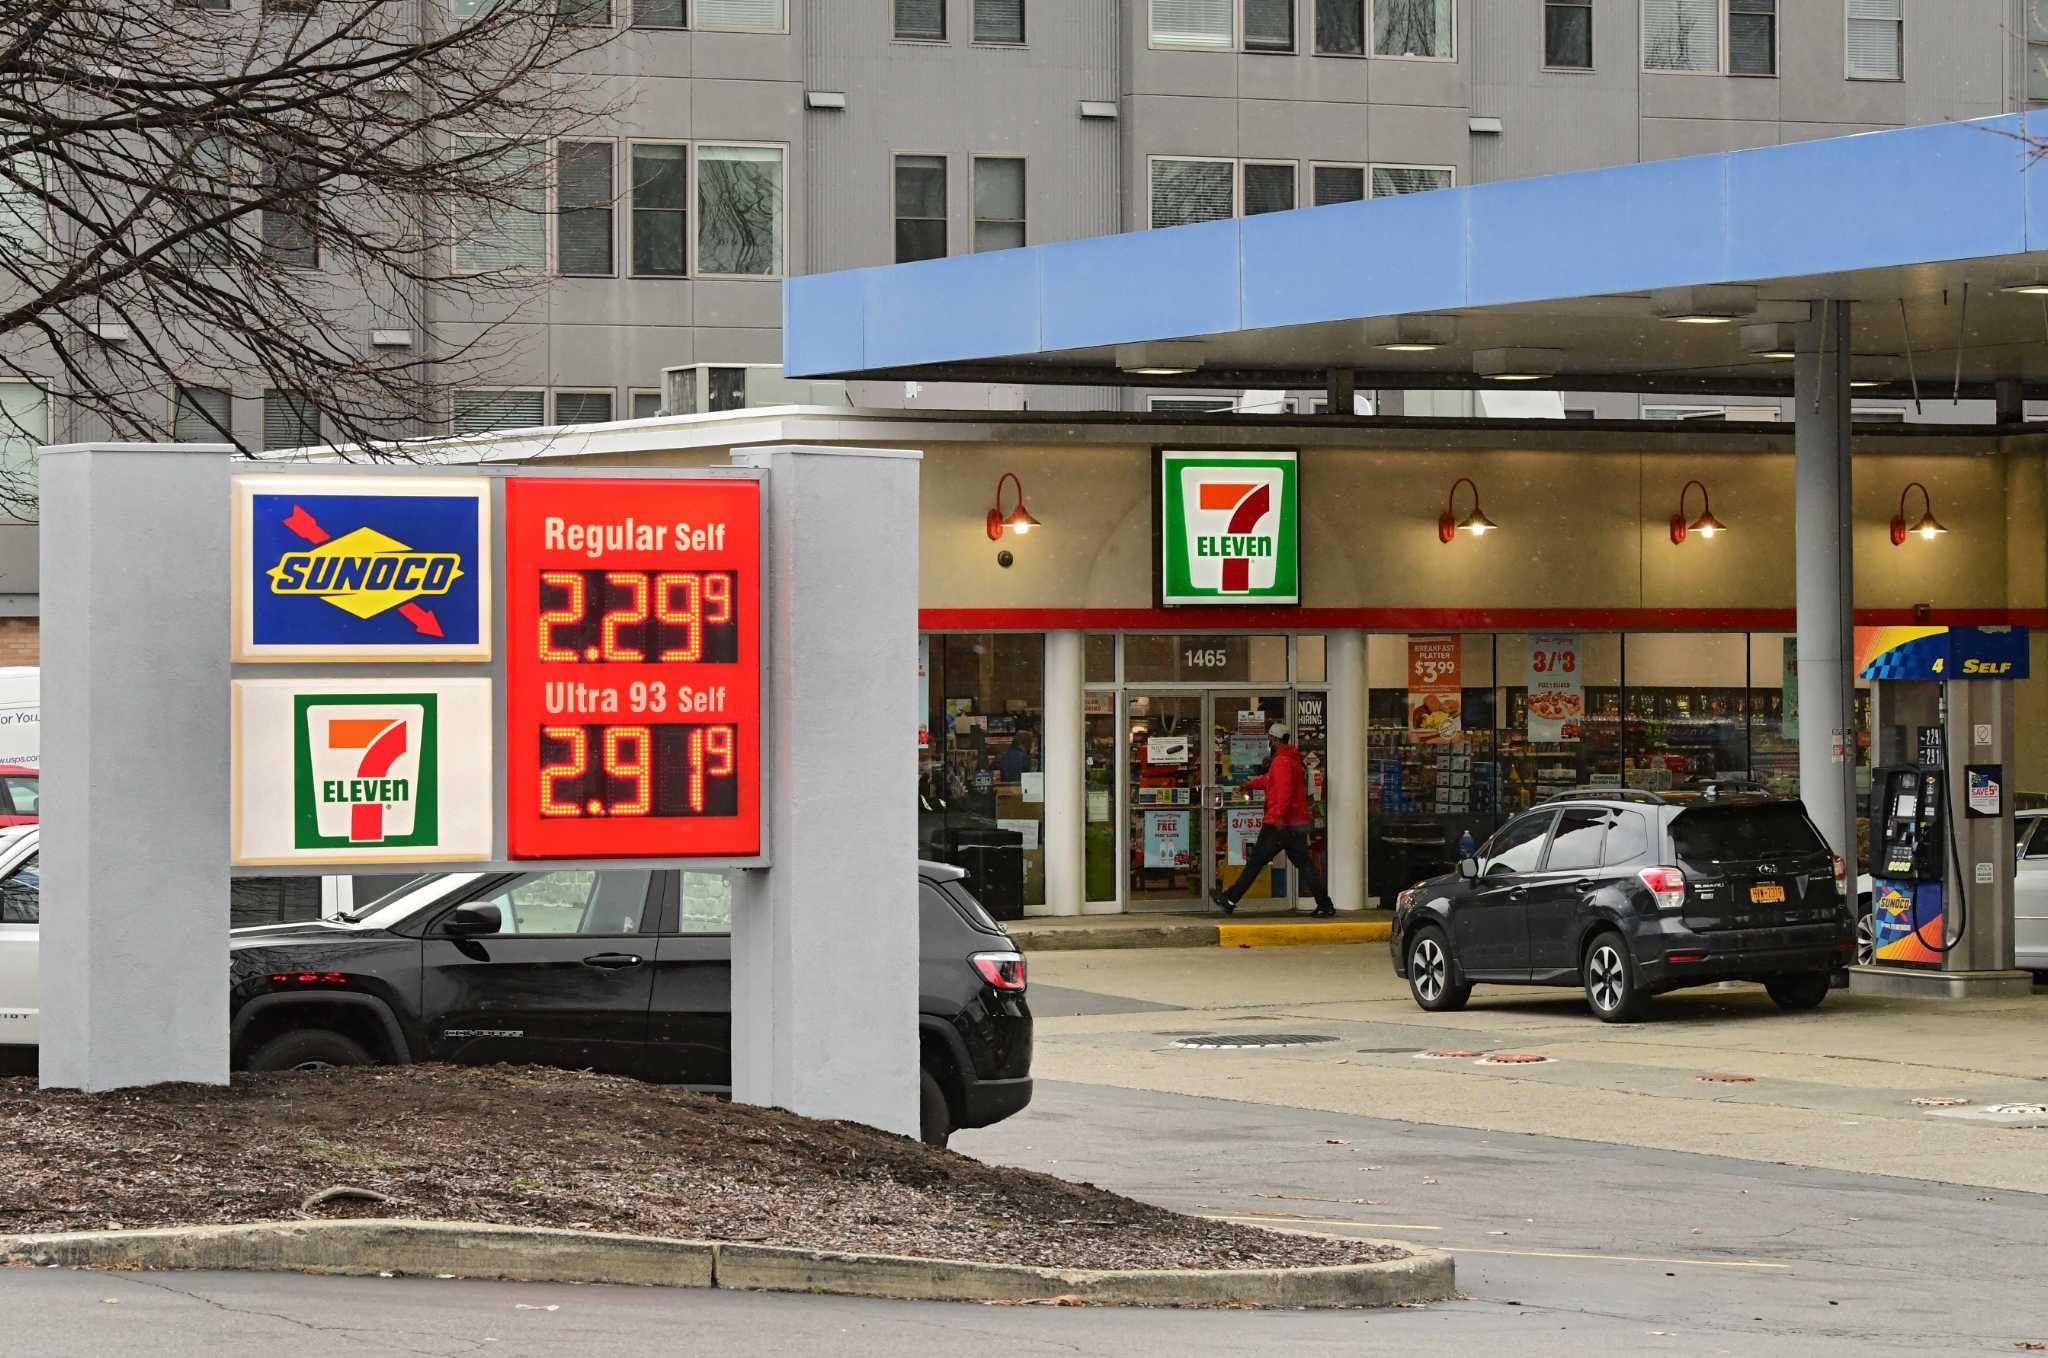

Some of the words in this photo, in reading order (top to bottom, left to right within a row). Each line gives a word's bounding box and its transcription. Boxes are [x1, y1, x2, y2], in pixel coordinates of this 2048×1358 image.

[544, 516, 668, 558] Regular
[674, 522, 726, 552] Self
[1199, 483, 1270, 592] 7
[276, 556, 456, 591] SUNOCO
[1185, 649, 1227, 667] 1465
[1931, 658, 1944, 673] 4
[545, 681, 618, 713] Ultra
[629, 681, 667, 713] 93
[678, 686, 726, 713] Self
[1298, 700, 1322, 715] NOW
[0, 713, 13, 724] or
[1299, 715, 1322, 725] HIRING
[328, 719, 407, 841] 7
[1971, 788, 1989, 796] SAVE
[1157, 823, 1177, 831] FREE
[1881, 898, 1909, 909] SUNOCO
